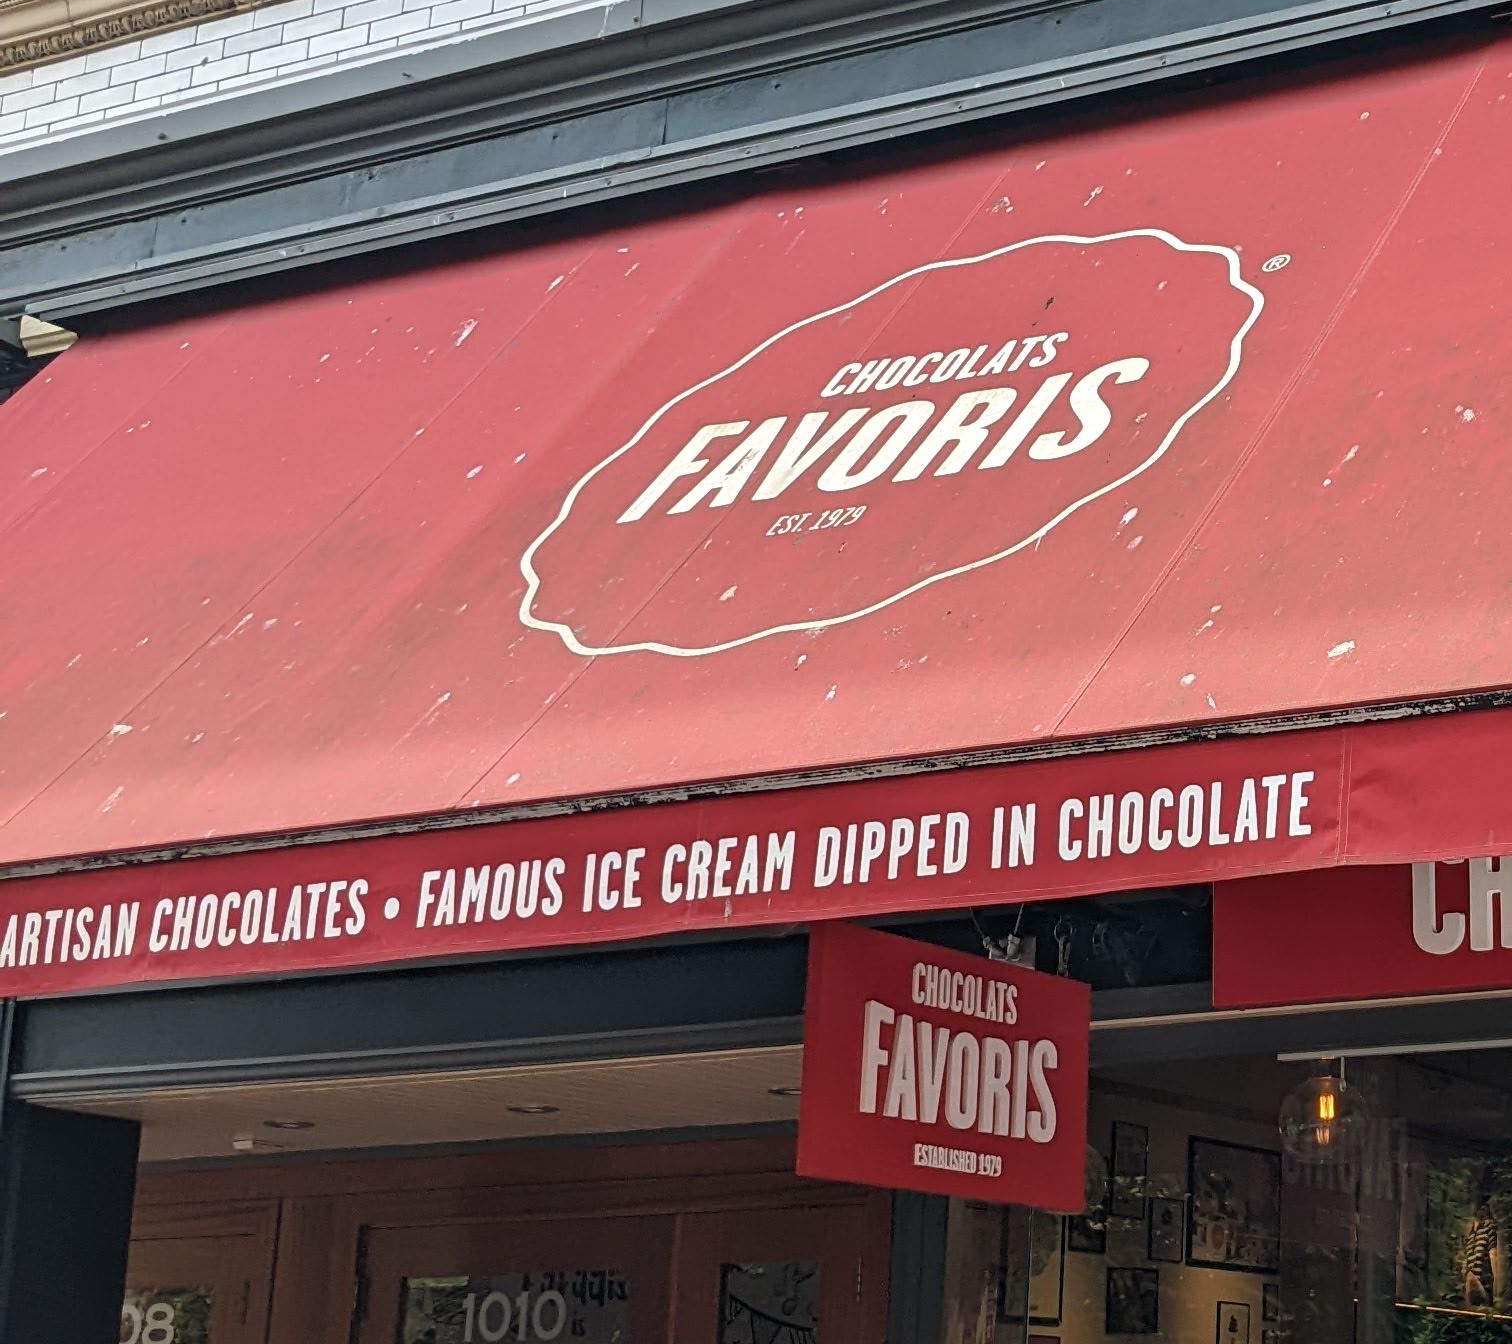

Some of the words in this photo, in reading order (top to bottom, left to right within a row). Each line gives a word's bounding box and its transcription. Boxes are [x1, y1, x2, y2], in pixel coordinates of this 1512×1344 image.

[820, 331, 1069, 399] CHOCOLATS
[615, 356, 1151, 525] FAVORIS
[766, 513, 812, 536] EST.
[809, 505, 867, 531] 1979
[0, 901, 140, 968] ARTISAN
[148, 878, 369, 953] CHOCOLATES
[416, 857, 567, 929] FAMOUS
[581, 847, 650, 914] ICE
[660, 829, 797, 905] CREAM
[813, 810, 970, 889] DIPPED
[990, 802, 1038, 870] IN
[1058, 770, 1315, 861] CHOCOLATE
[911, 962, 1018, 1025] CHOCOLATS
[858, 998, 1059, 1144] FAVORIS
[913, 1142, 978, 1176] ESTABLISHED
[976, 1152, 1003, 1178] 1979
[462, 1290, 567, 1343] 1010
